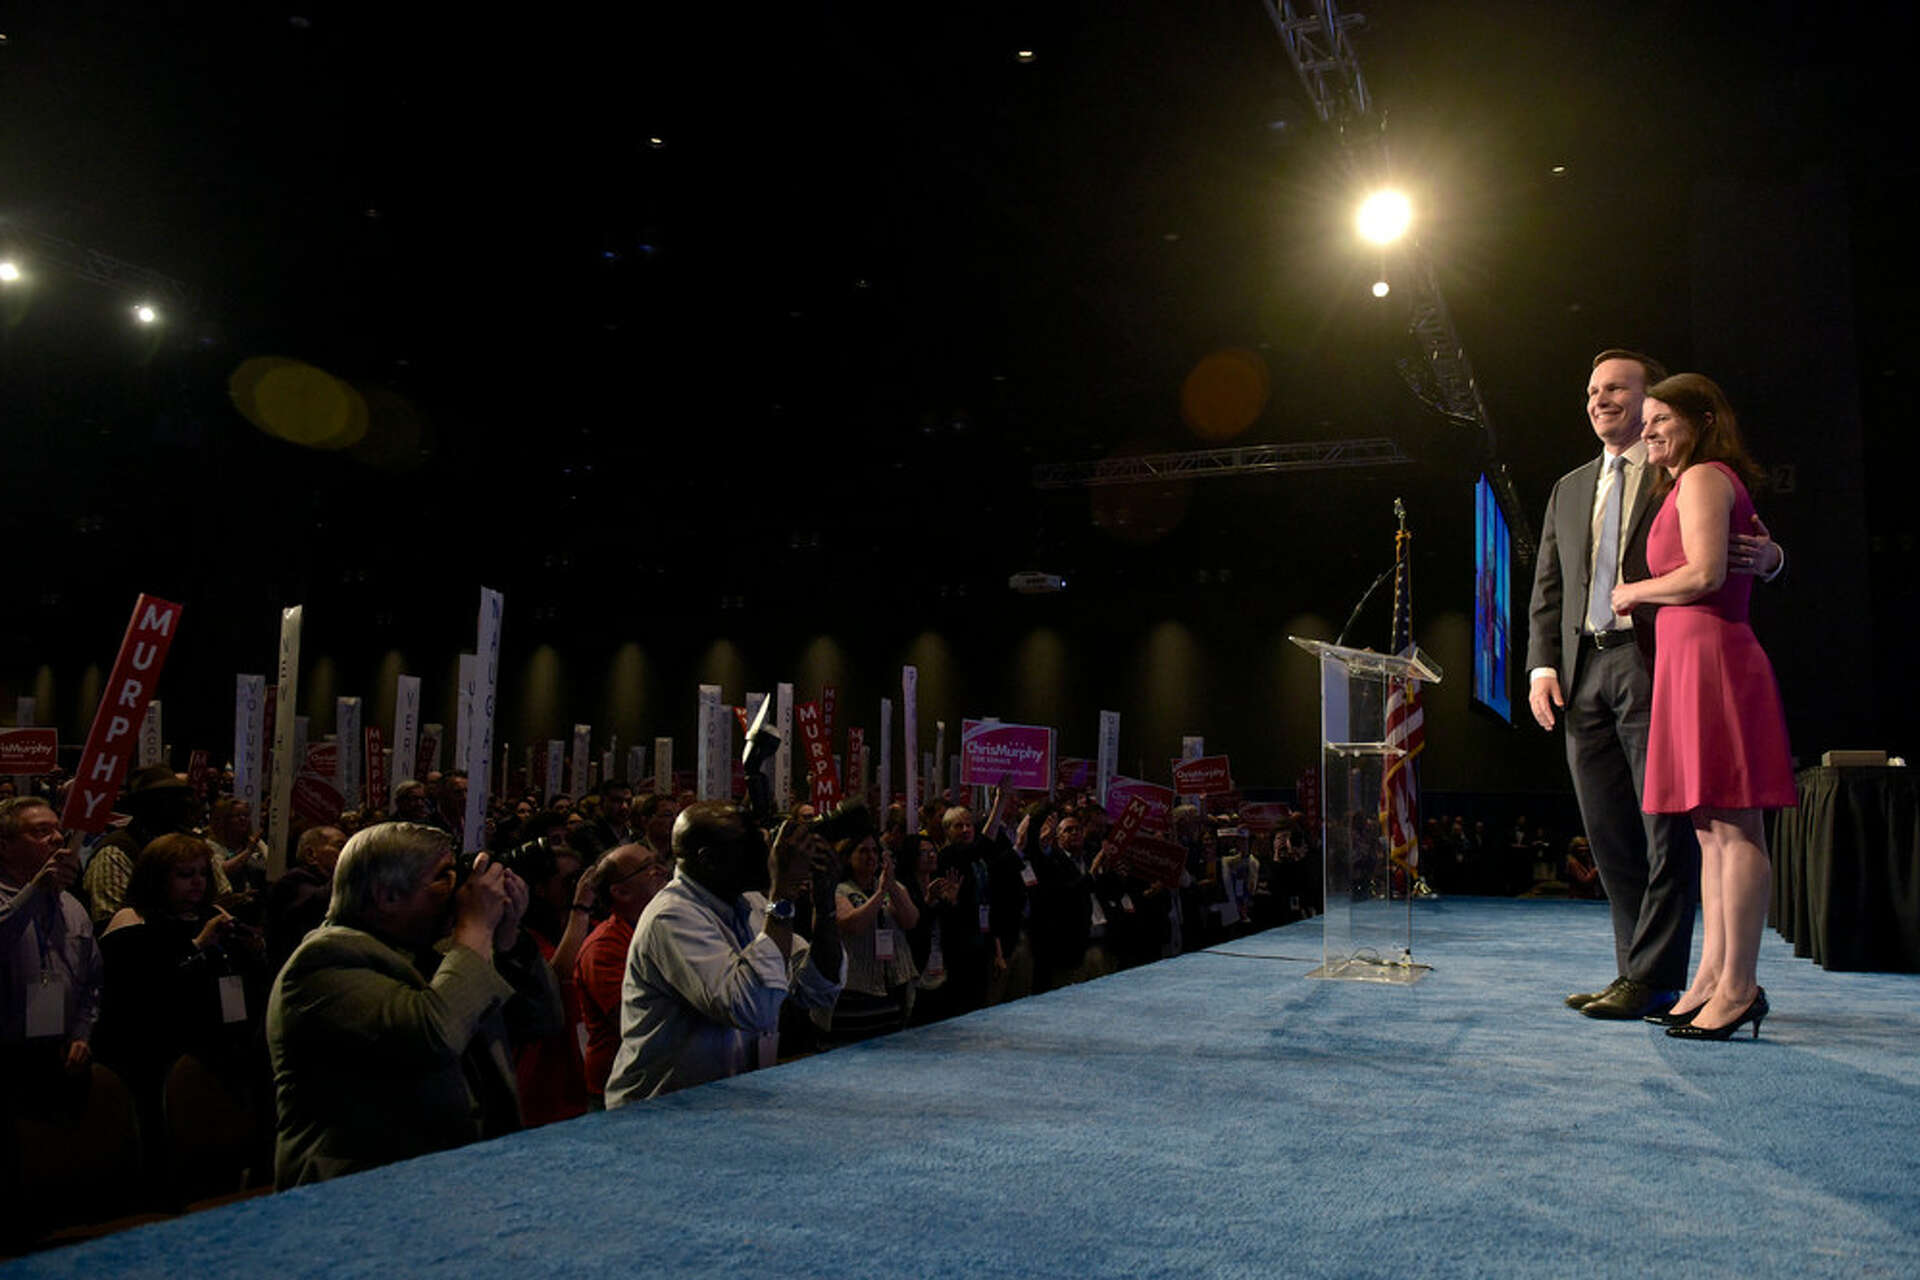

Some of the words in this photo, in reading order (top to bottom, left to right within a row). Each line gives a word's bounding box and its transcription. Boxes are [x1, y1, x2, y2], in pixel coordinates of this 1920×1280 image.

[83, 604, 174, 820] MURPHY
[244, 681, 257, 799] VOLUNTO
[402, 691, 416, 777] VERN
[475, 597, 501, 849] NAUGATUC
[967, 740, 1045, 765] ChrisMurphy
